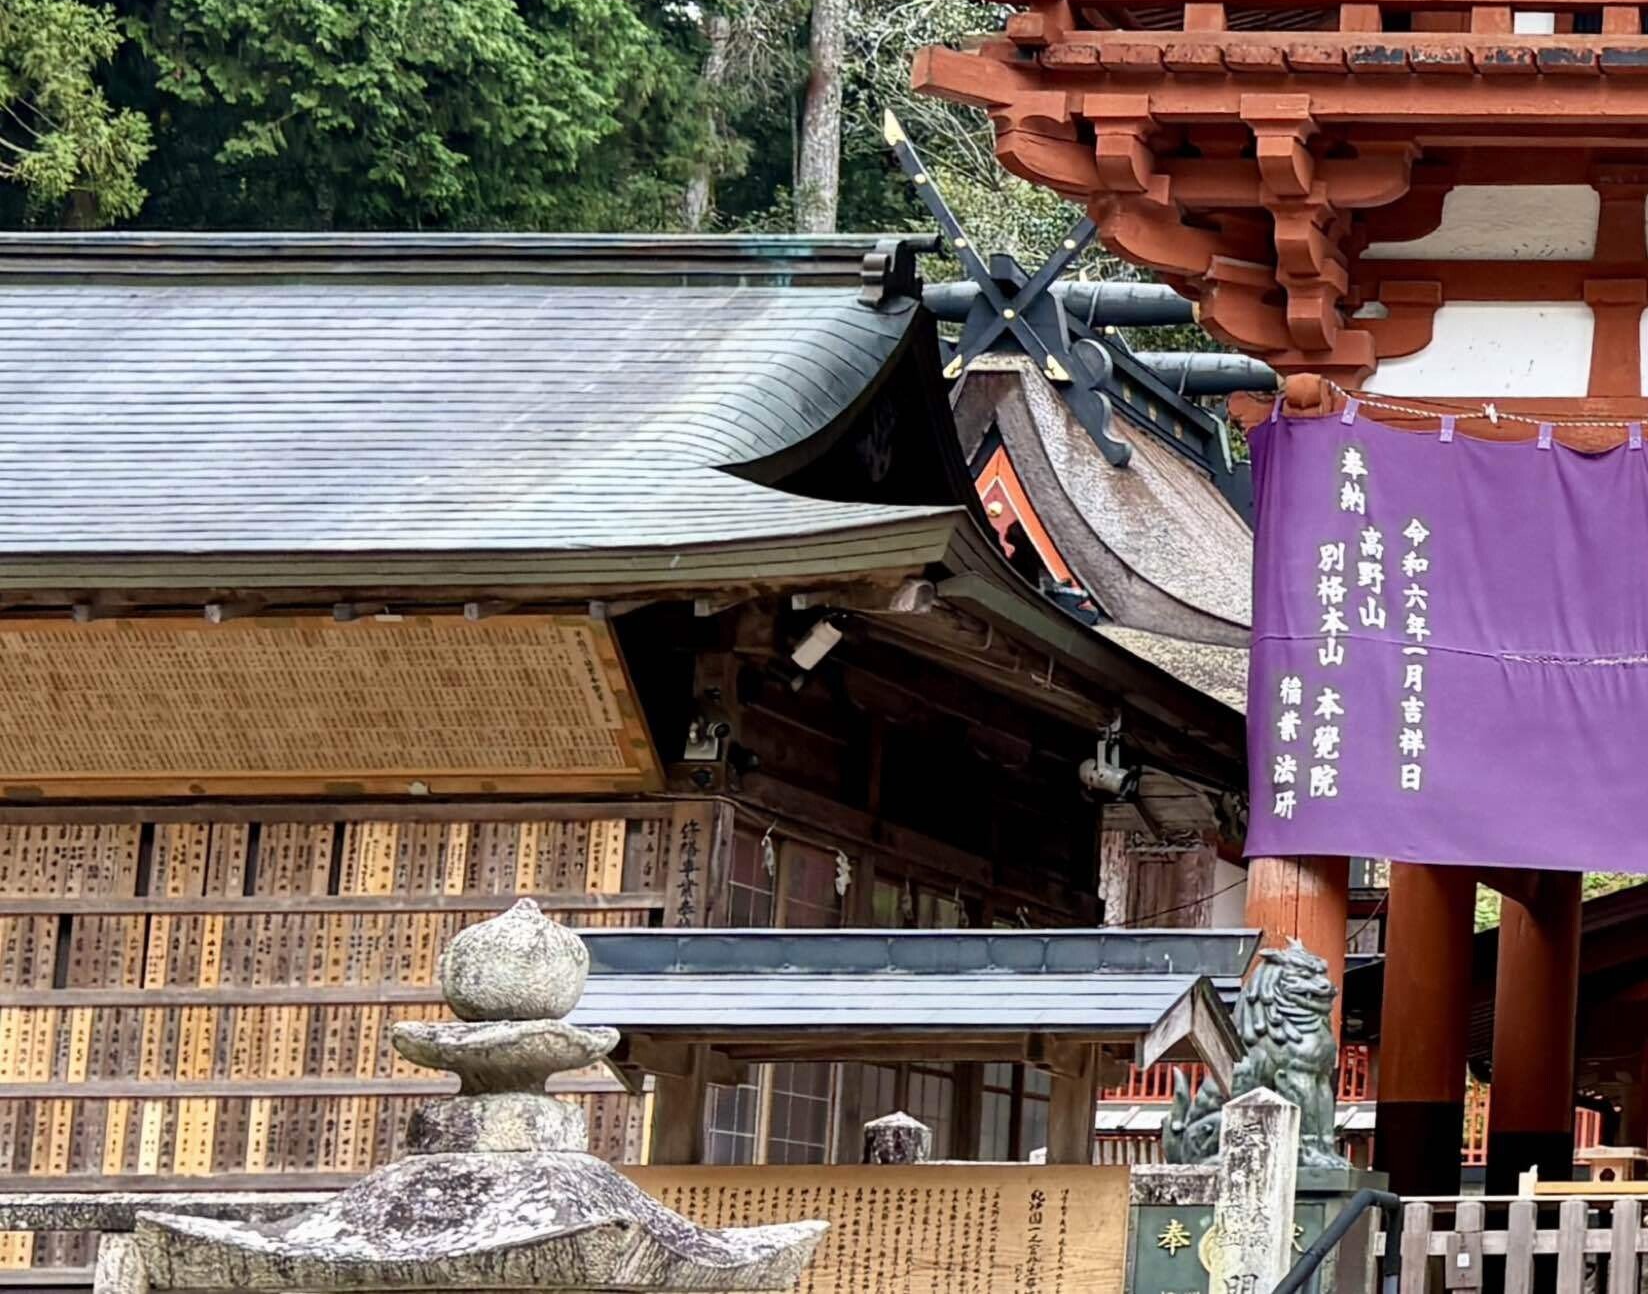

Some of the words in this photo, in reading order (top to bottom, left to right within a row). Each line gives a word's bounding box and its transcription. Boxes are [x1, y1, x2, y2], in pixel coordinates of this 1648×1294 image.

[1340, 446, 1369, 515] 奉納
[1317, 541, 1349, 667] 別格本山
[1357, 525, 1387, 629] 高野山
[1398, 517, 1431, 792] 令和六年一月吉祥日
[1157, 1218, 1192, 1256] 奉
